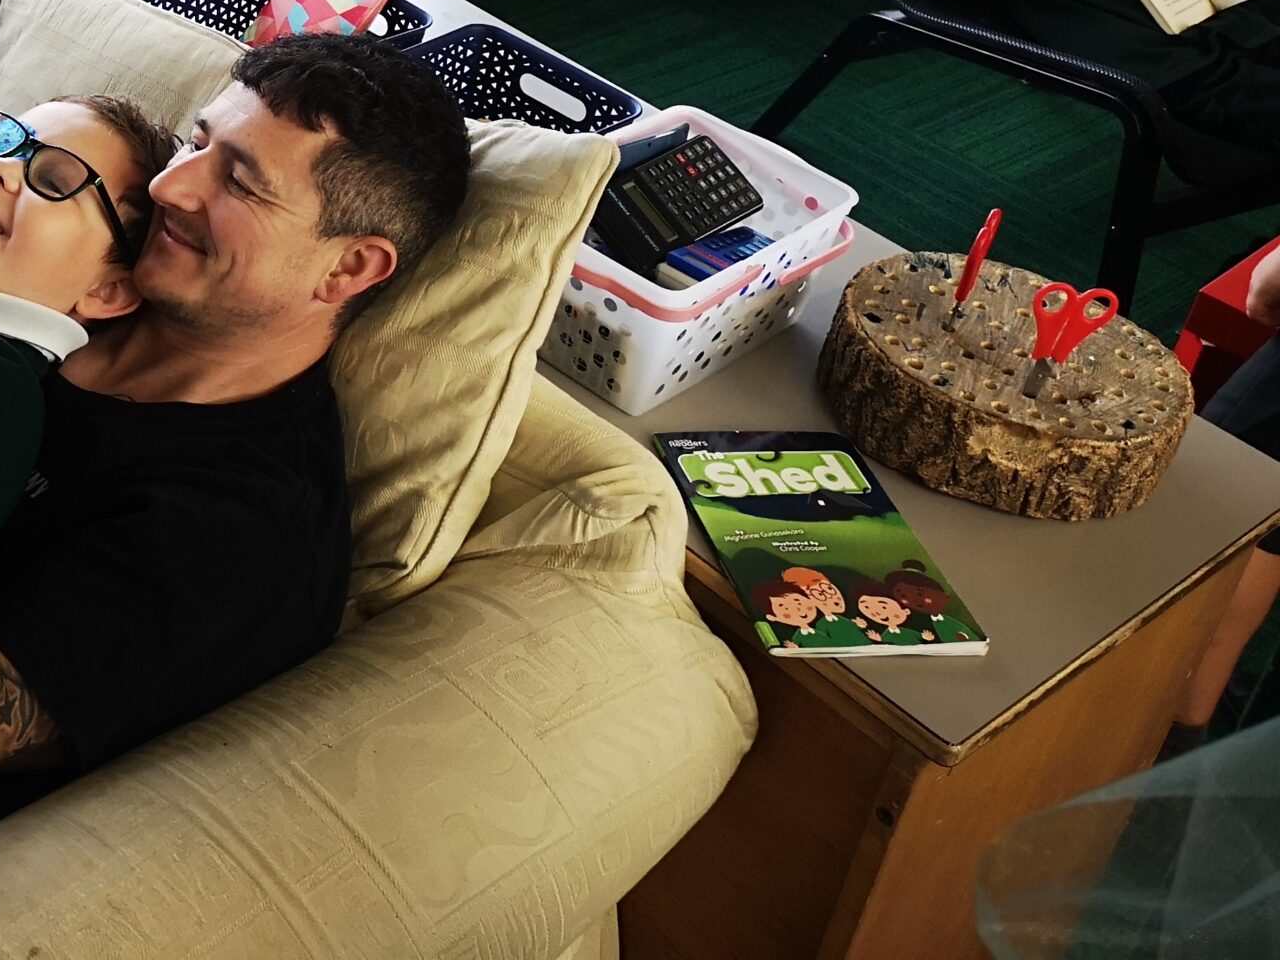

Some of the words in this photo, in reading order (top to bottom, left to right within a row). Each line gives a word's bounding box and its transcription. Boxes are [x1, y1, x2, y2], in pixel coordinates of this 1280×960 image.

[668, 438, 708, 450] Readers
[693, 450, 725, 462] The
[704, 454, 857, 498] Shed
[779, 545, 800, 553] Chris
